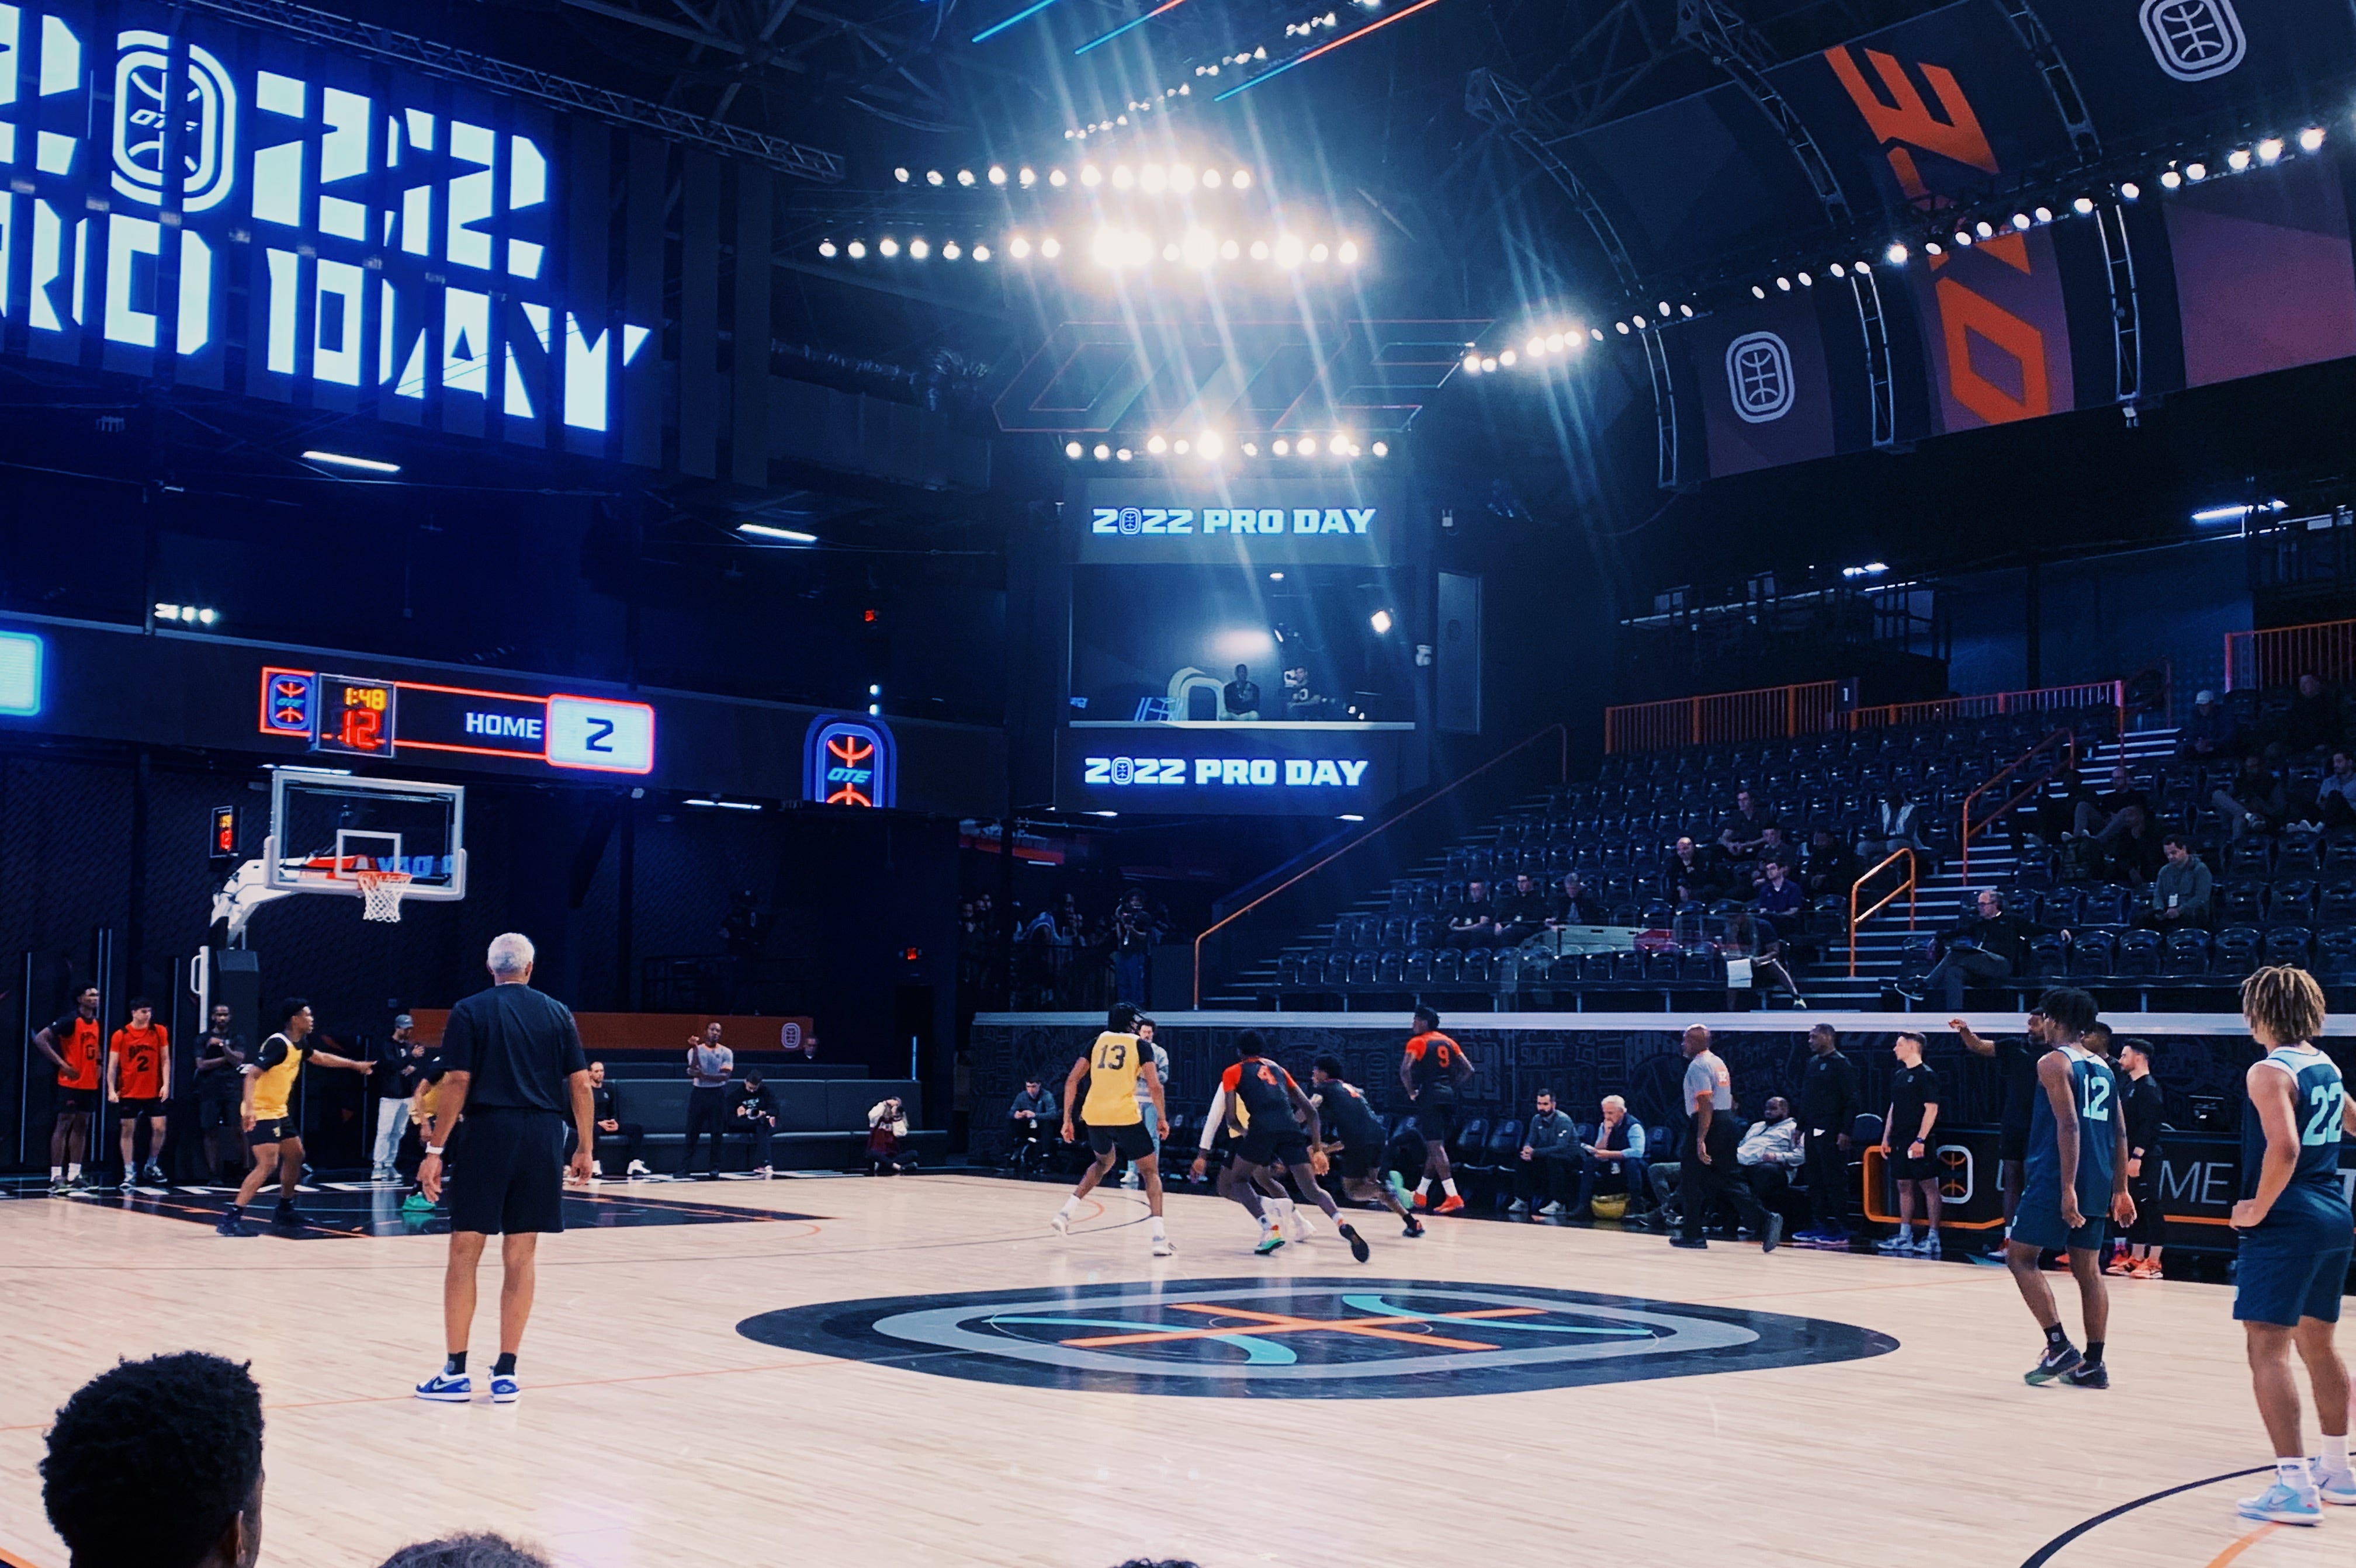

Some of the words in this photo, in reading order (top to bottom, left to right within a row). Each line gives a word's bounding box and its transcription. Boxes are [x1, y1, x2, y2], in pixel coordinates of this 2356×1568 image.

[266, 246, 650, 431] DAY
[1093, 507, 1193, 535] 2022
[1203, 509, 1284, 535] PRO
[1293, 508, 1377, 534] DAY
[345, 688, 387, 711] 1:48
[342, 708, 381, 749] 12
[466, 712, 543, 740] HOME
[585, 717, 614, 752] 2
[827, 766, 872, 783] OTE
[1085, 757, 1186, 785] 2022
[1194, 758, 1277, 786] PRO
[1284, 759, 1368, 786] DAY
[137, 1055, 149, 1072] 2
[1096, 1044, 1127, 1071] 13
[1437, 1046, 1449, 1067] 9
[2083, 1073, 2110, 1122] 12
[2302, 1081, 2344, 1146] 22
